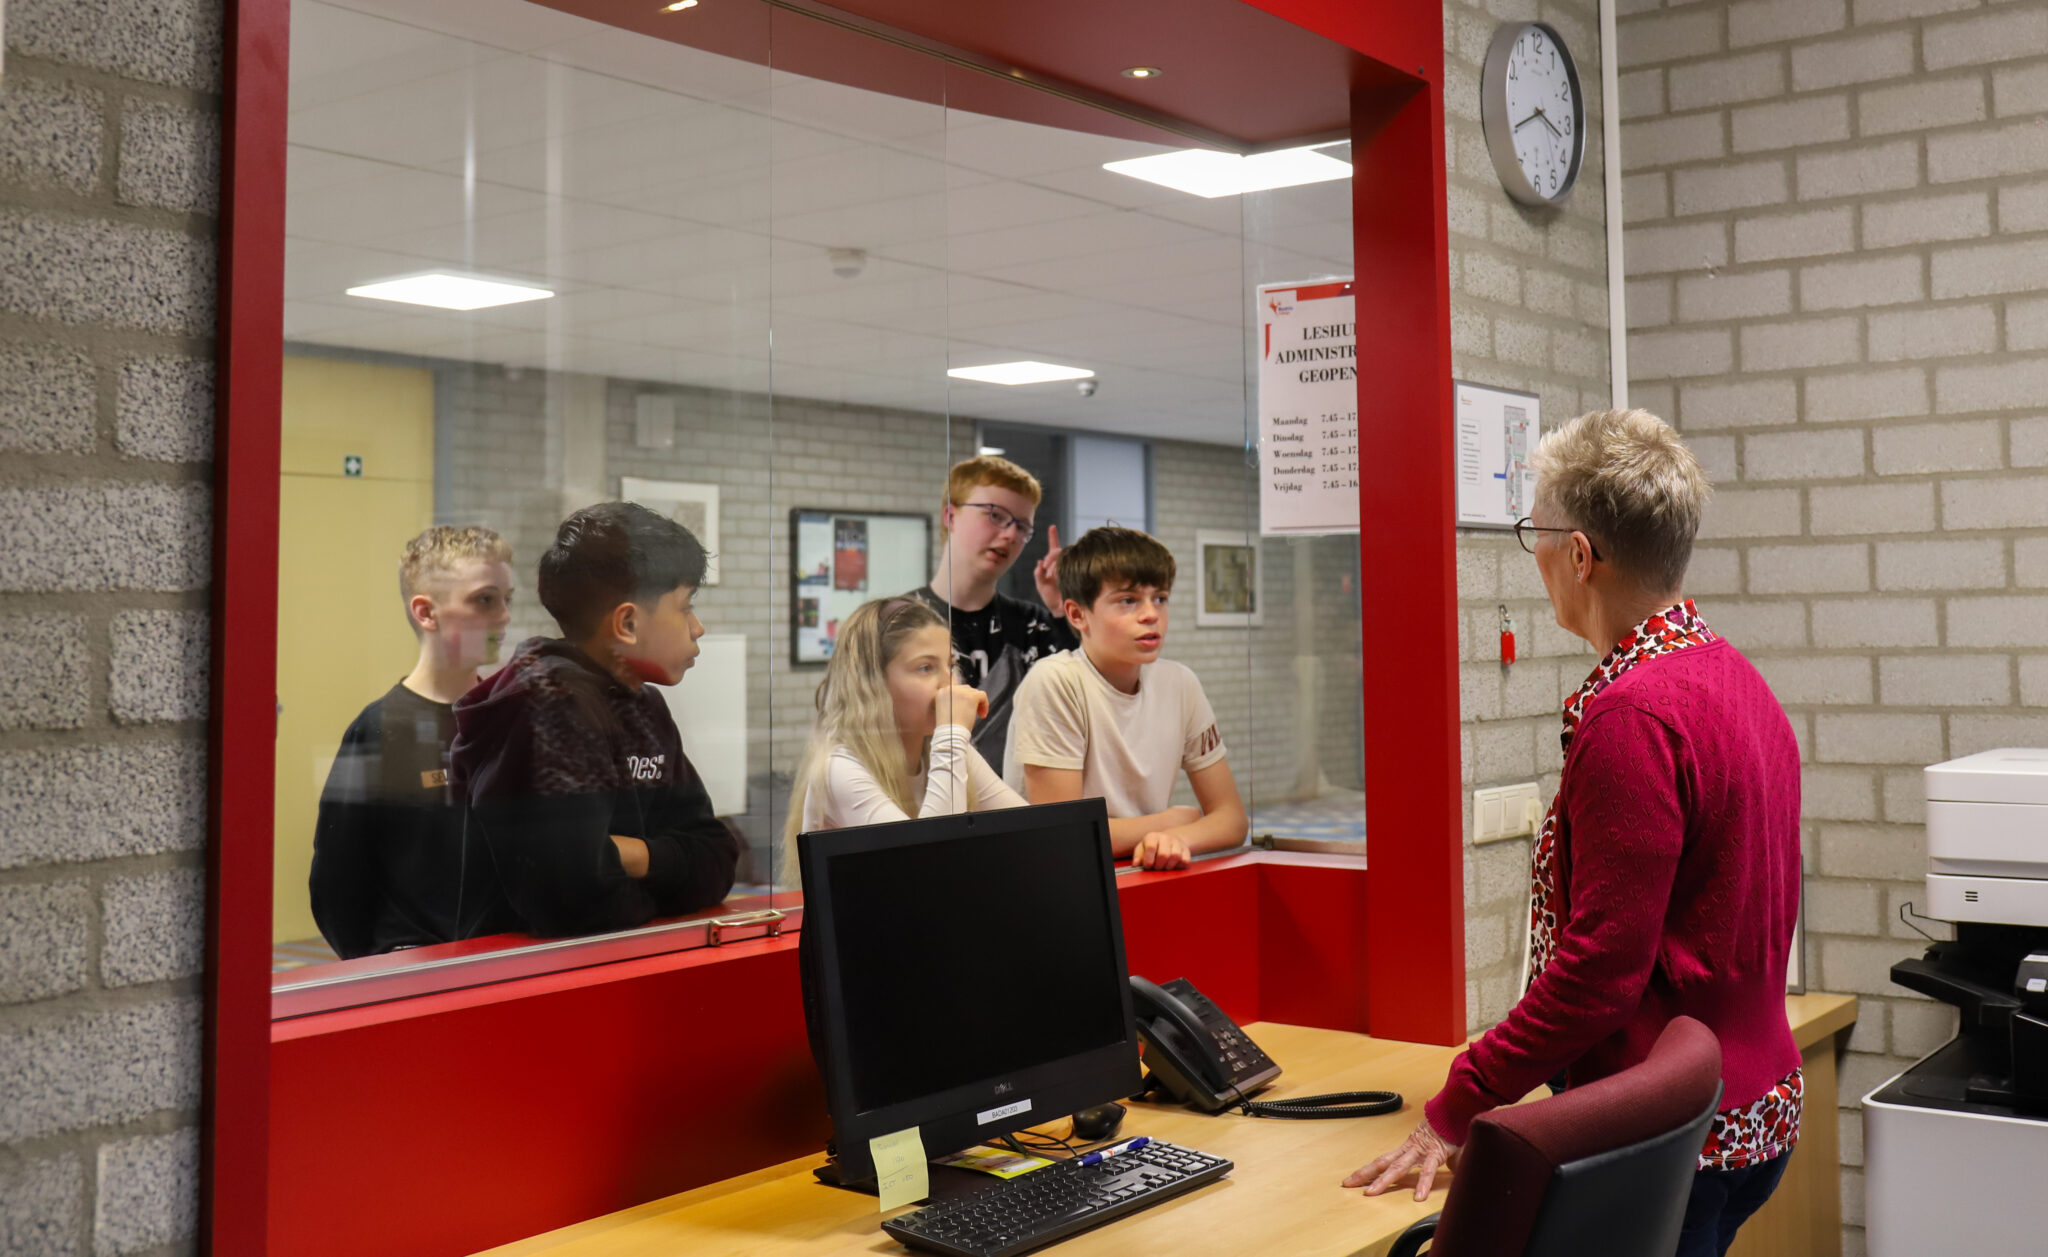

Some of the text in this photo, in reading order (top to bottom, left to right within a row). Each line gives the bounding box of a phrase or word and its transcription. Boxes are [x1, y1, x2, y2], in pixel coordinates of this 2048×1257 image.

[1516, 39, 1525, 58] 11
[1531, 32, 1543, 54] 12
[1550, 51, 1555, 70] 1
[1561, 81, 1569, 101] 2
[1564, 115, 1571, 136] 3
[1560, 148, 1566, 168] 4
[1534, 174, 1542, 195] 6
[1550, 169, 1557, 190] 5
[1272, 416, 1308, 427] Maandag
[1273, 433, 1304, 443] Dinsdag
[1273, 449, 1313, 460] Woensdag
[1273, 466, 1316, 476] Donderdag
[1273, 483, 1303, 493] Vrijdag
